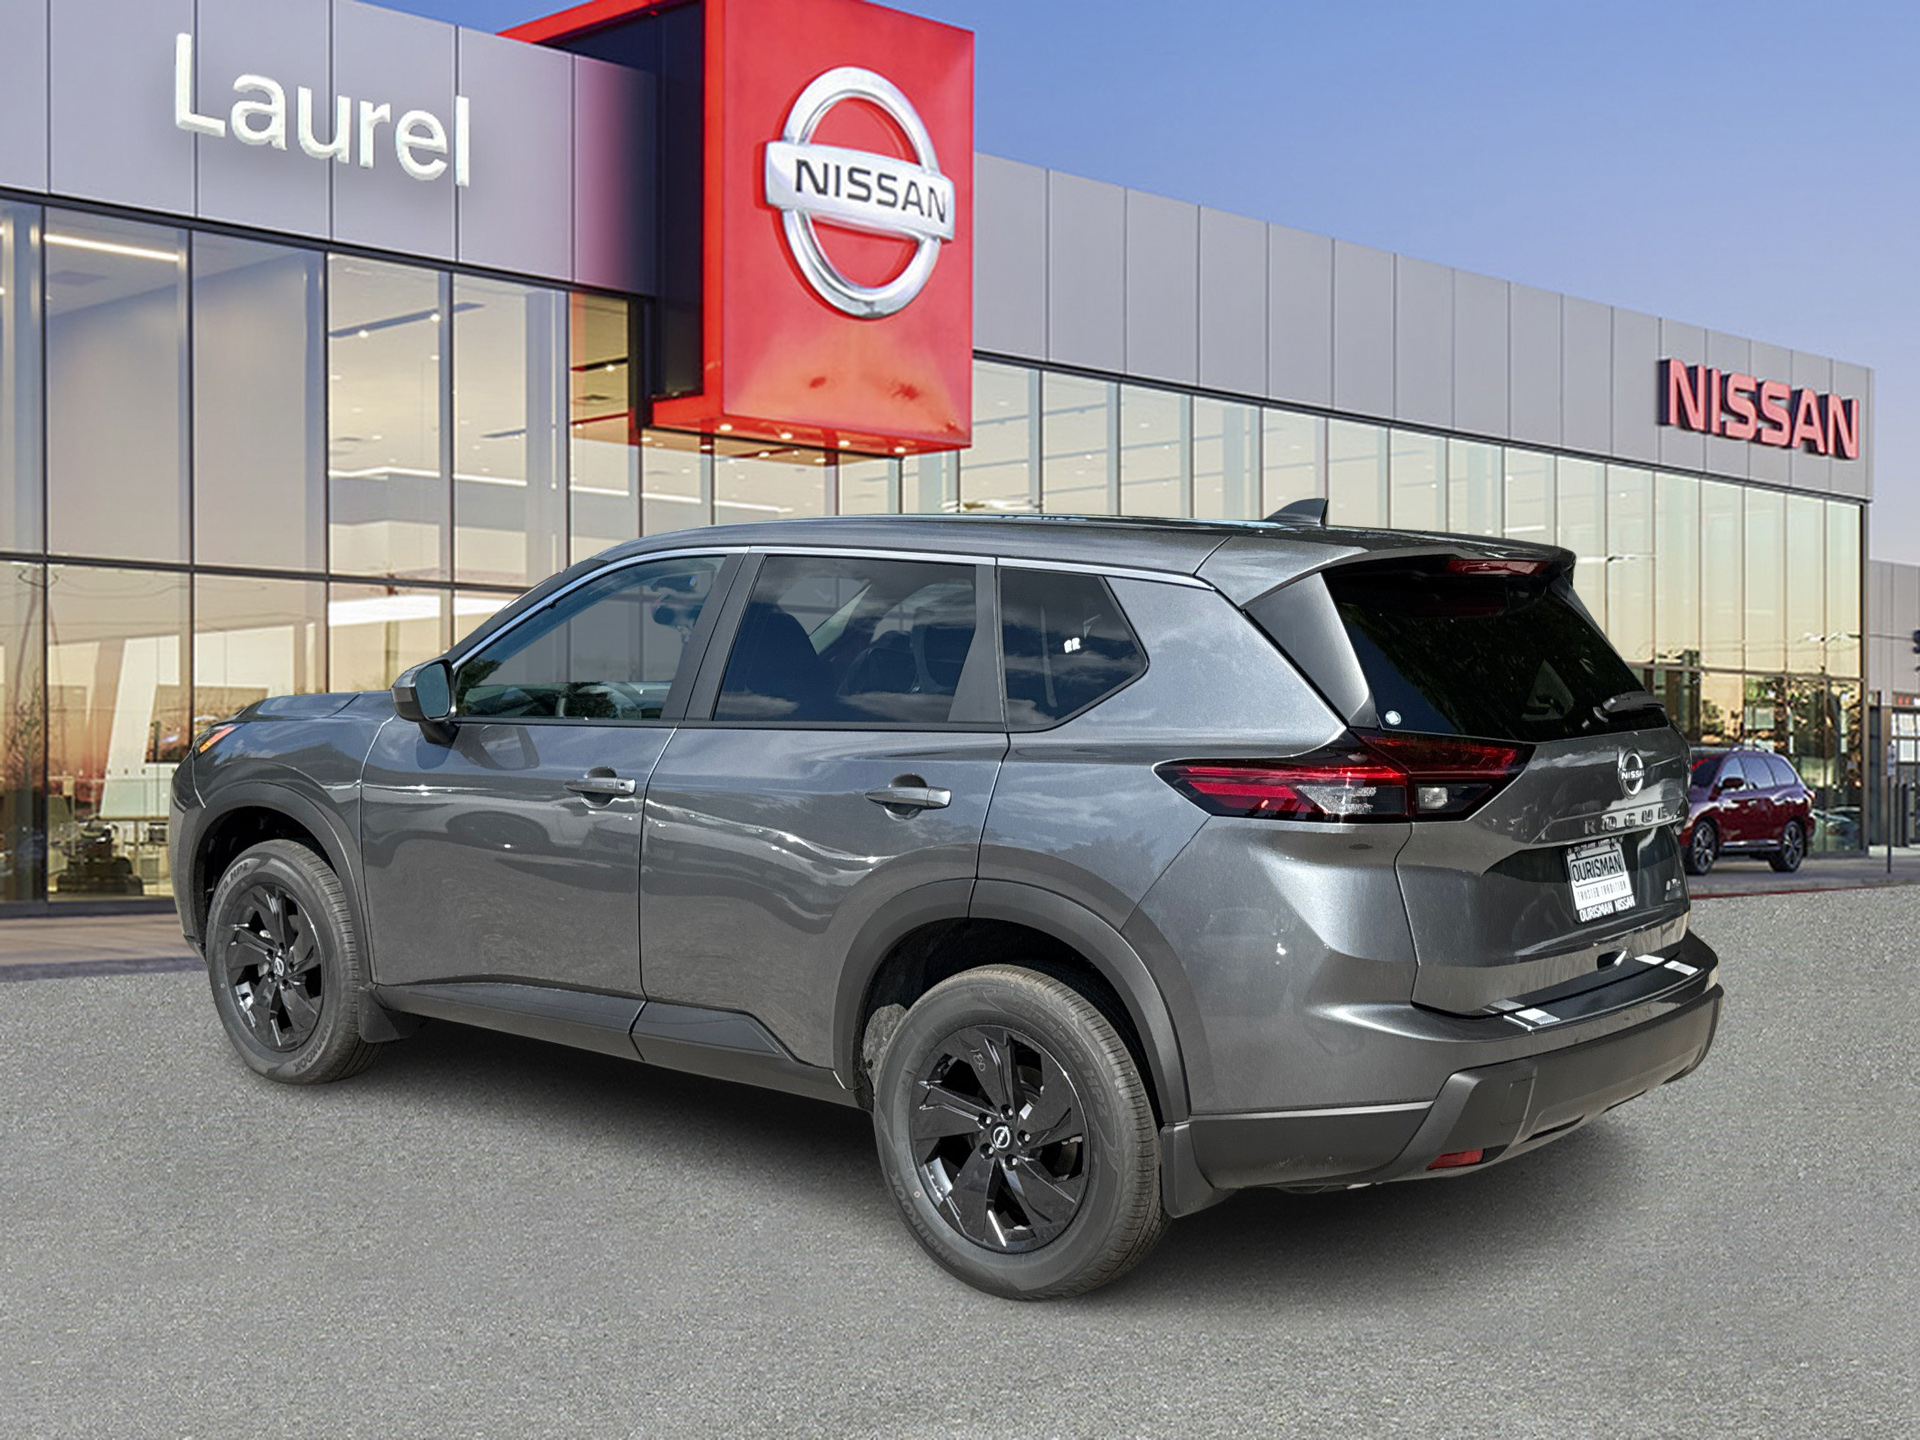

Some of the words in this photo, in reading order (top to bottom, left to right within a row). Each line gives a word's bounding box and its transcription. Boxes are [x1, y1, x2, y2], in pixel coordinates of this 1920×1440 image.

[175, 32, 470, 188] Laurel
[795, 158, 946, 223] NISSAN
[1658, 358, 1860, 459] NISSAN
[1584, 806, 1669, 835] ROGUE
[1571, 854, 1625, 882] OURISMAN
[1579, 901, 1614, 922] OURISMAN
[1614, 894, 1636, 911] NISSAN
